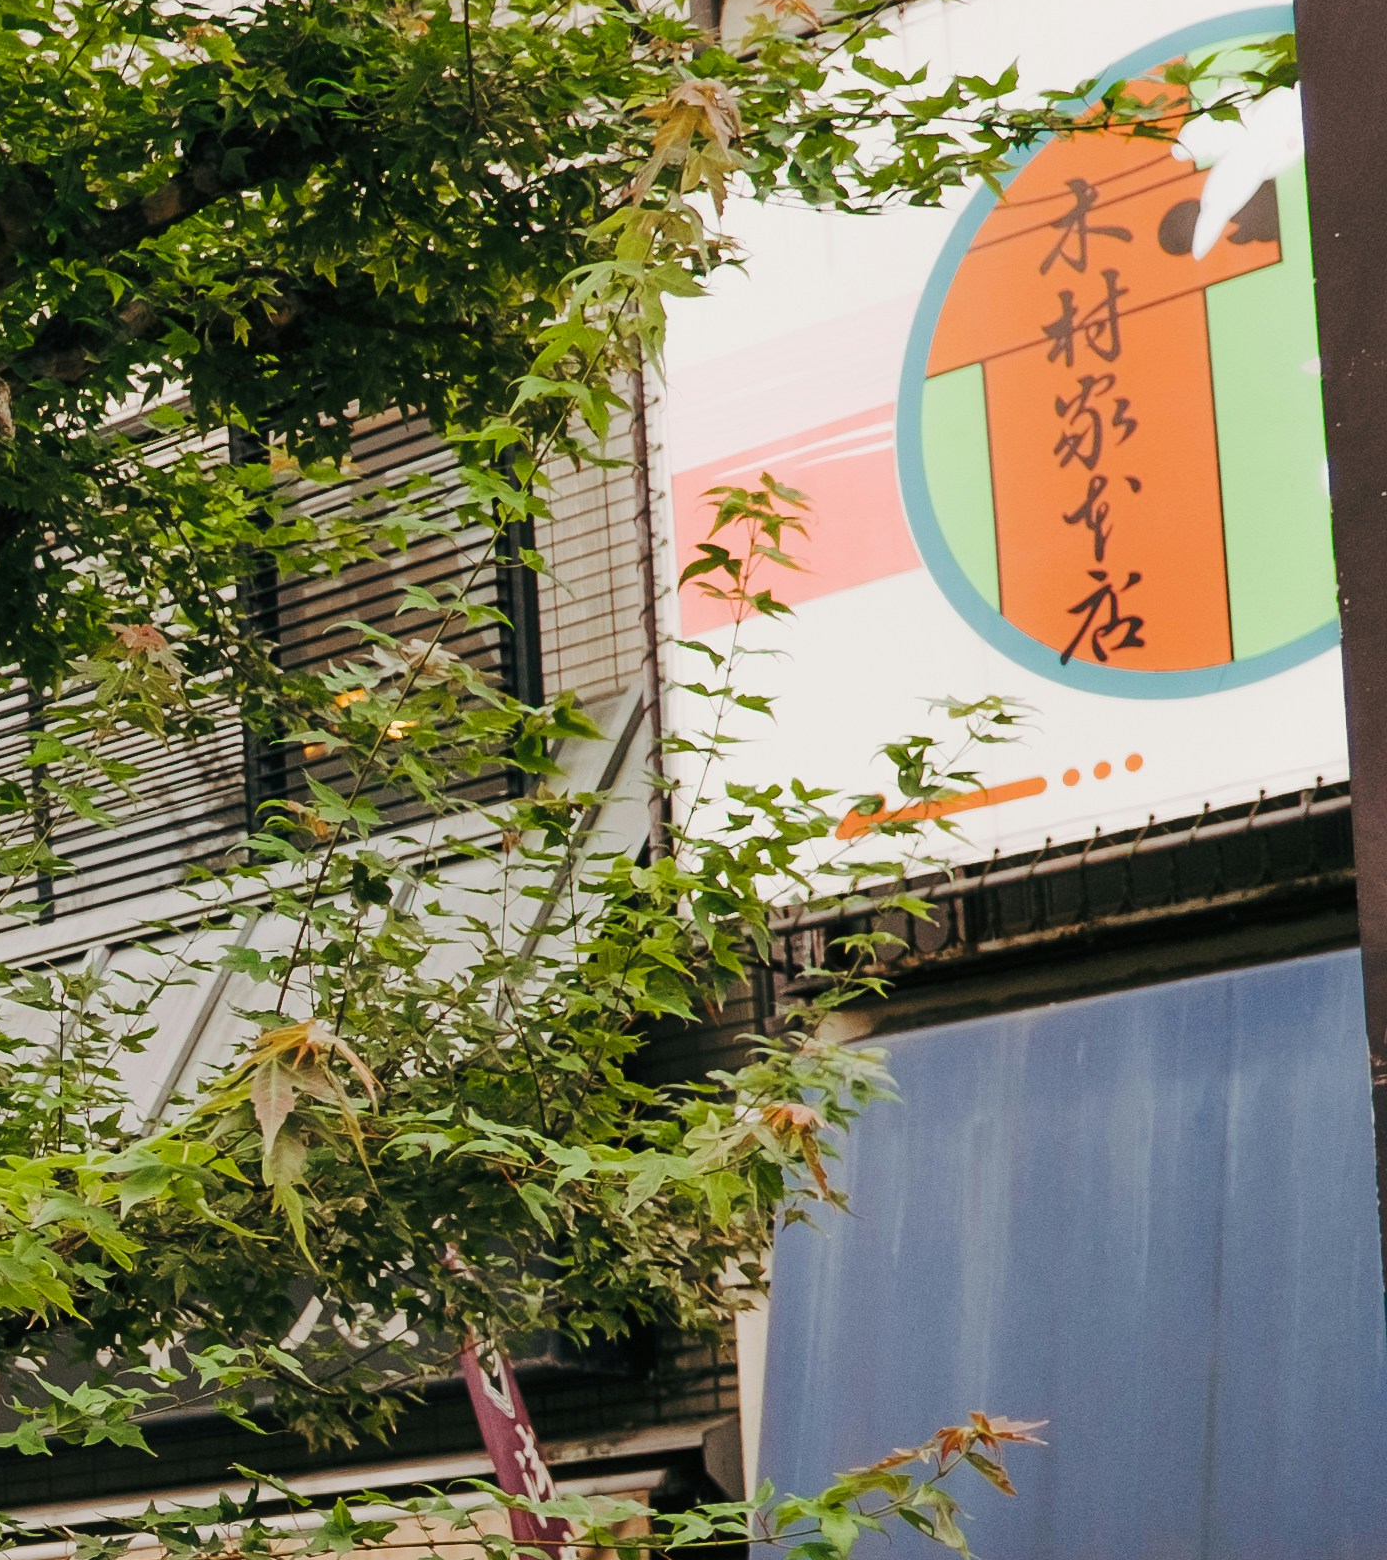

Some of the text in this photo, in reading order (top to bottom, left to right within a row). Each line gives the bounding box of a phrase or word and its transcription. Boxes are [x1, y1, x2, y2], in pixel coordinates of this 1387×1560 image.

[1039, 177, 1146, 666] 木村家本店
